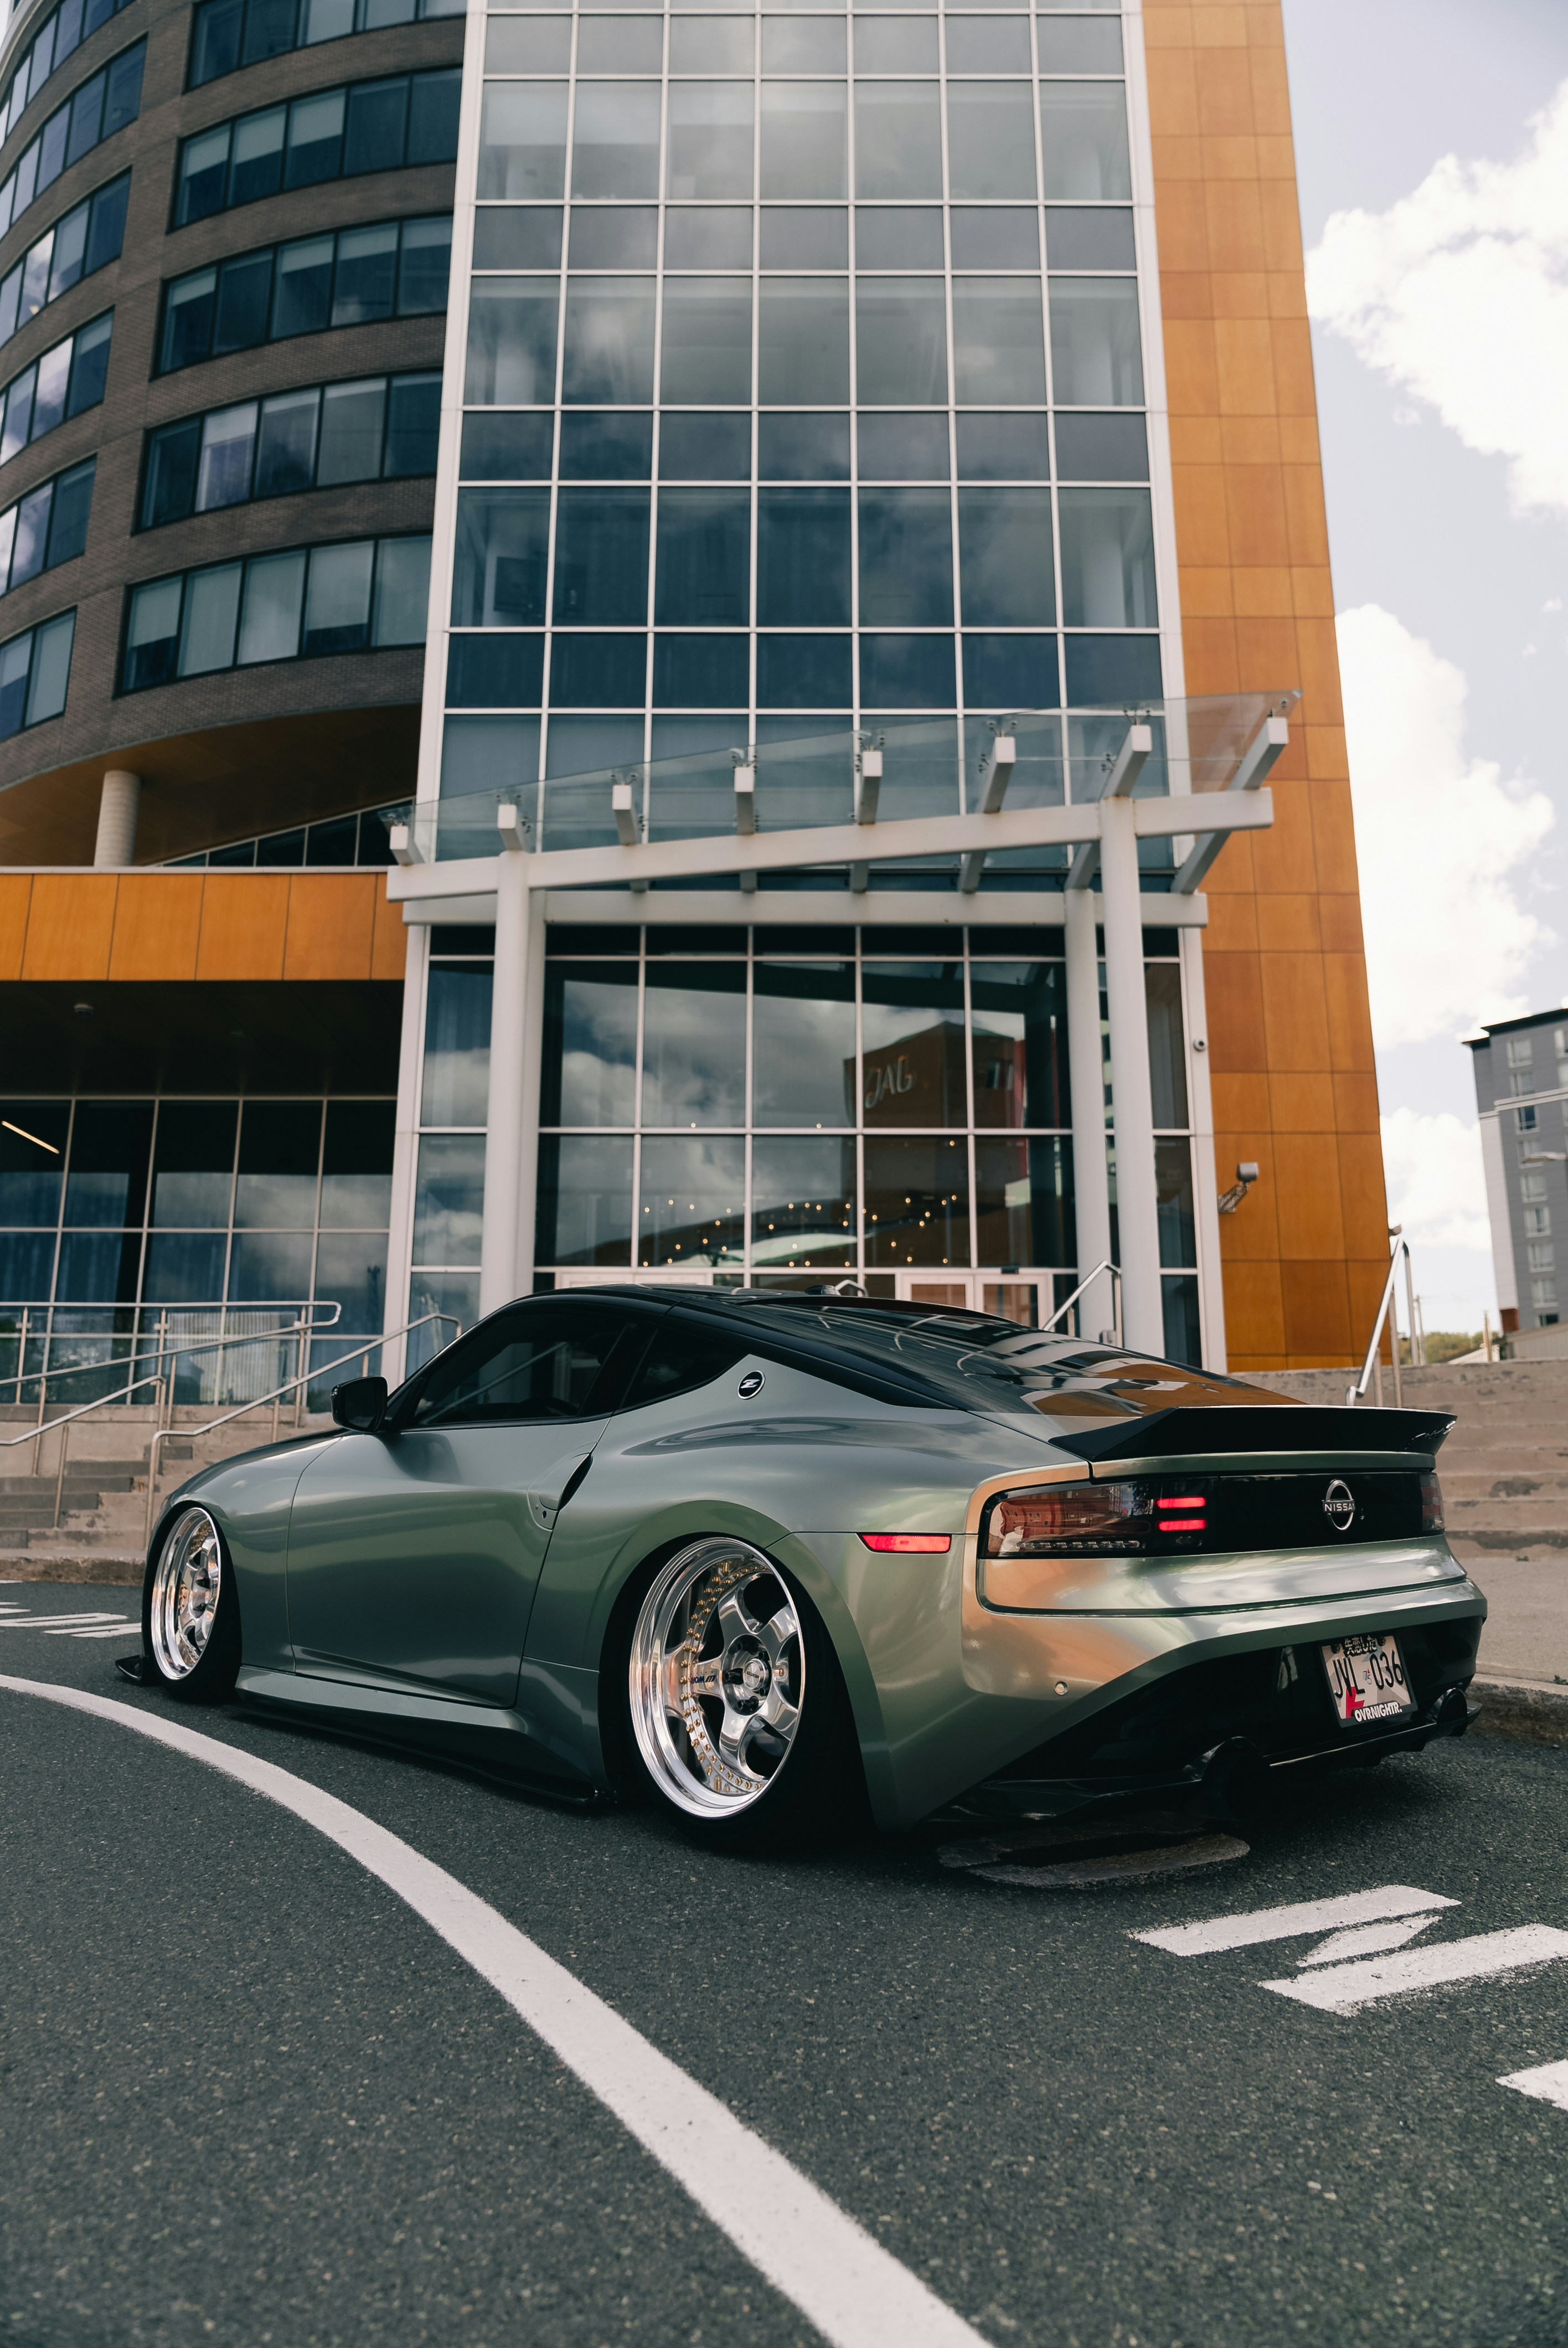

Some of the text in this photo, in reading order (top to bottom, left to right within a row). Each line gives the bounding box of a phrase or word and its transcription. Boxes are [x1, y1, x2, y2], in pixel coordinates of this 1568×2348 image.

[1332, 1657, 1366, 1698] JVL
[1369, 1650, 1404, 1690] 036
[1354, 1702, 1403, 1722] OVRNIGHTR.
